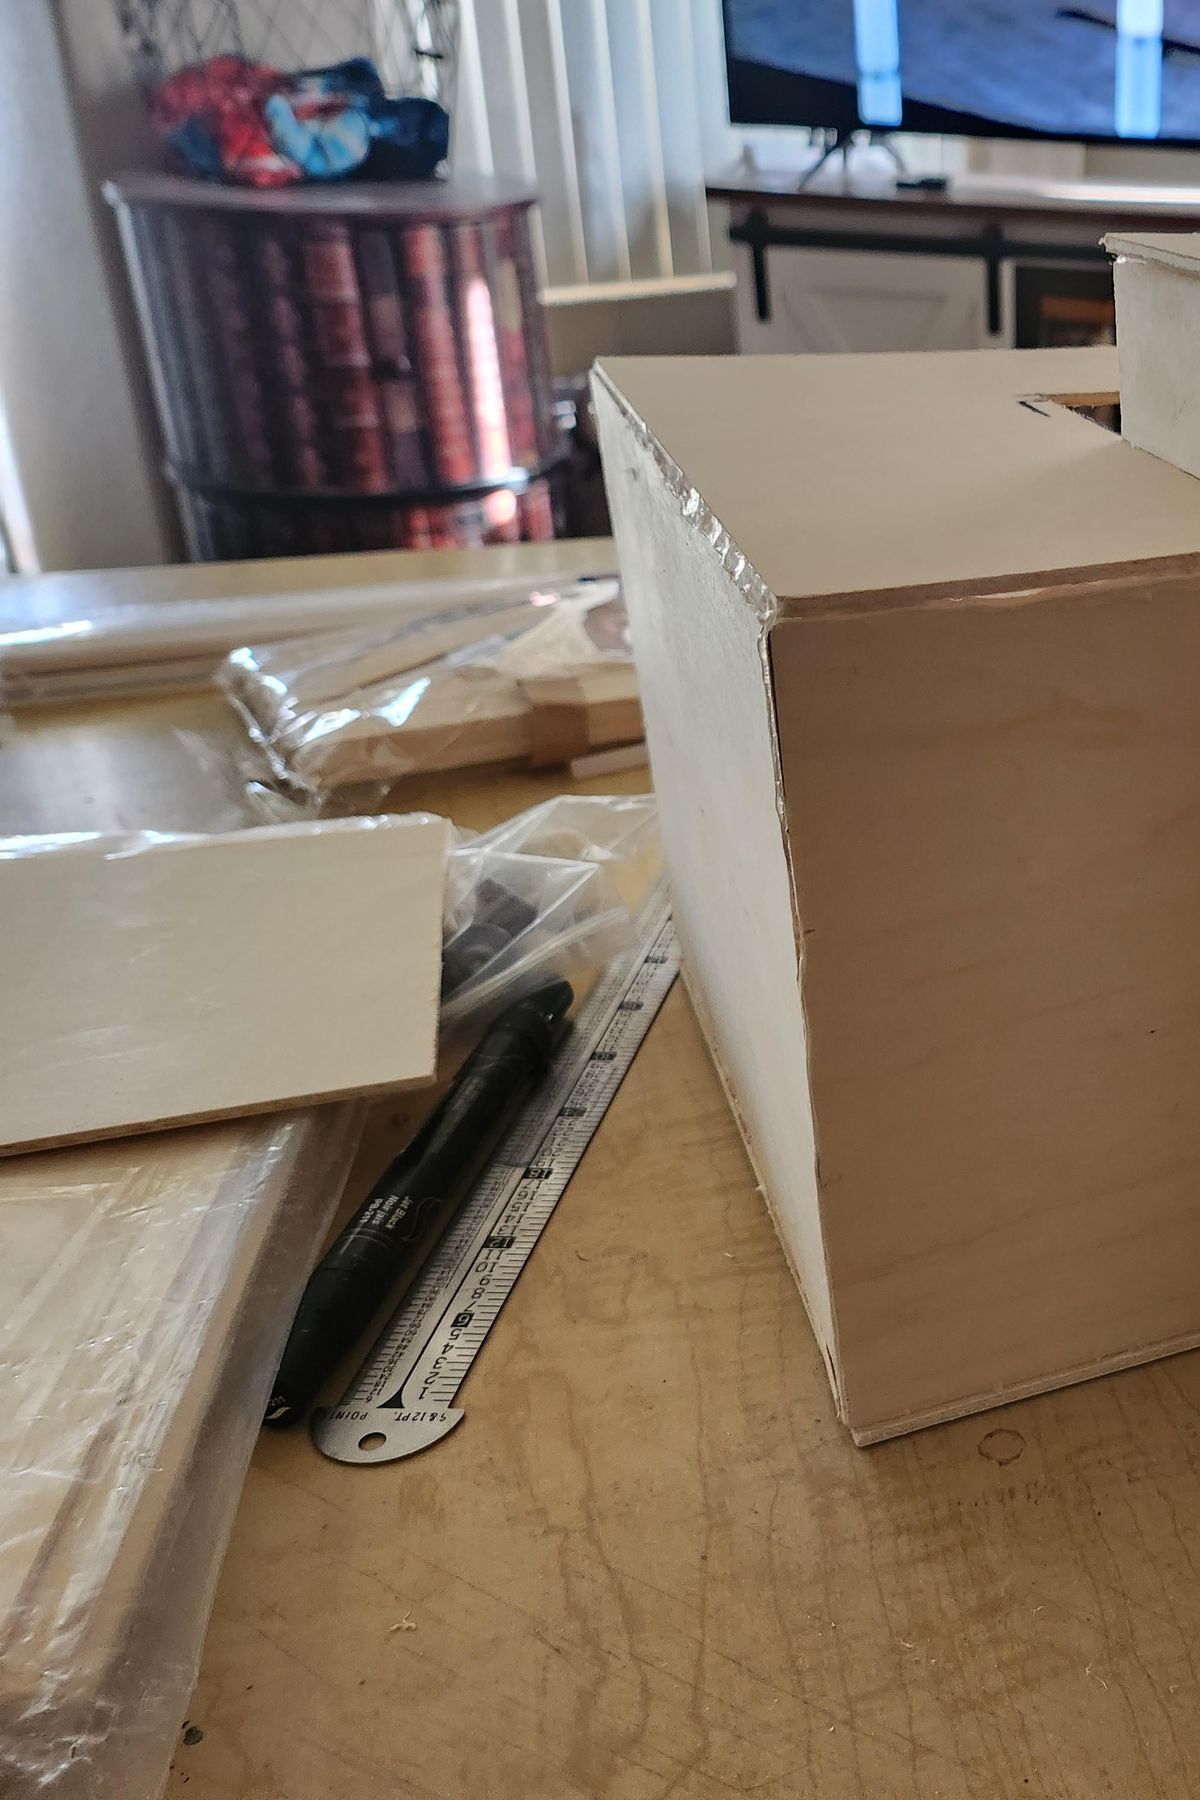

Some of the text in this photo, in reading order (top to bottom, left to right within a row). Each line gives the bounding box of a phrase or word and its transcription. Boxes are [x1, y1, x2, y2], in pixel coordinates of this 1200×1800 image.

[524, 1180, 543, 1190] 17
[517, 1190, 538, 1201] 16
[510, 1202, 532, 1212] 15
[504, 1214, 525, 1224] 14
[496, 1225, 519, 1235] 13
[485, 1249, 504, 1260] 11
[475, 1261, 498, 1273] 10
[479, 1274, 492, 1285] 9
[473, 1287, 486, 1299] 8
[465, 1301, 477, 1312] 7
[457, 1314, 471, 1326] 6
[449, 1328, 463, 1341] 5
[443, 1342, 455, 1354] 4
[434, 1356, 448, 1369] 3
[424, 1371, 440, 1384] 2
[418, 1387, 429, 1400] 1
